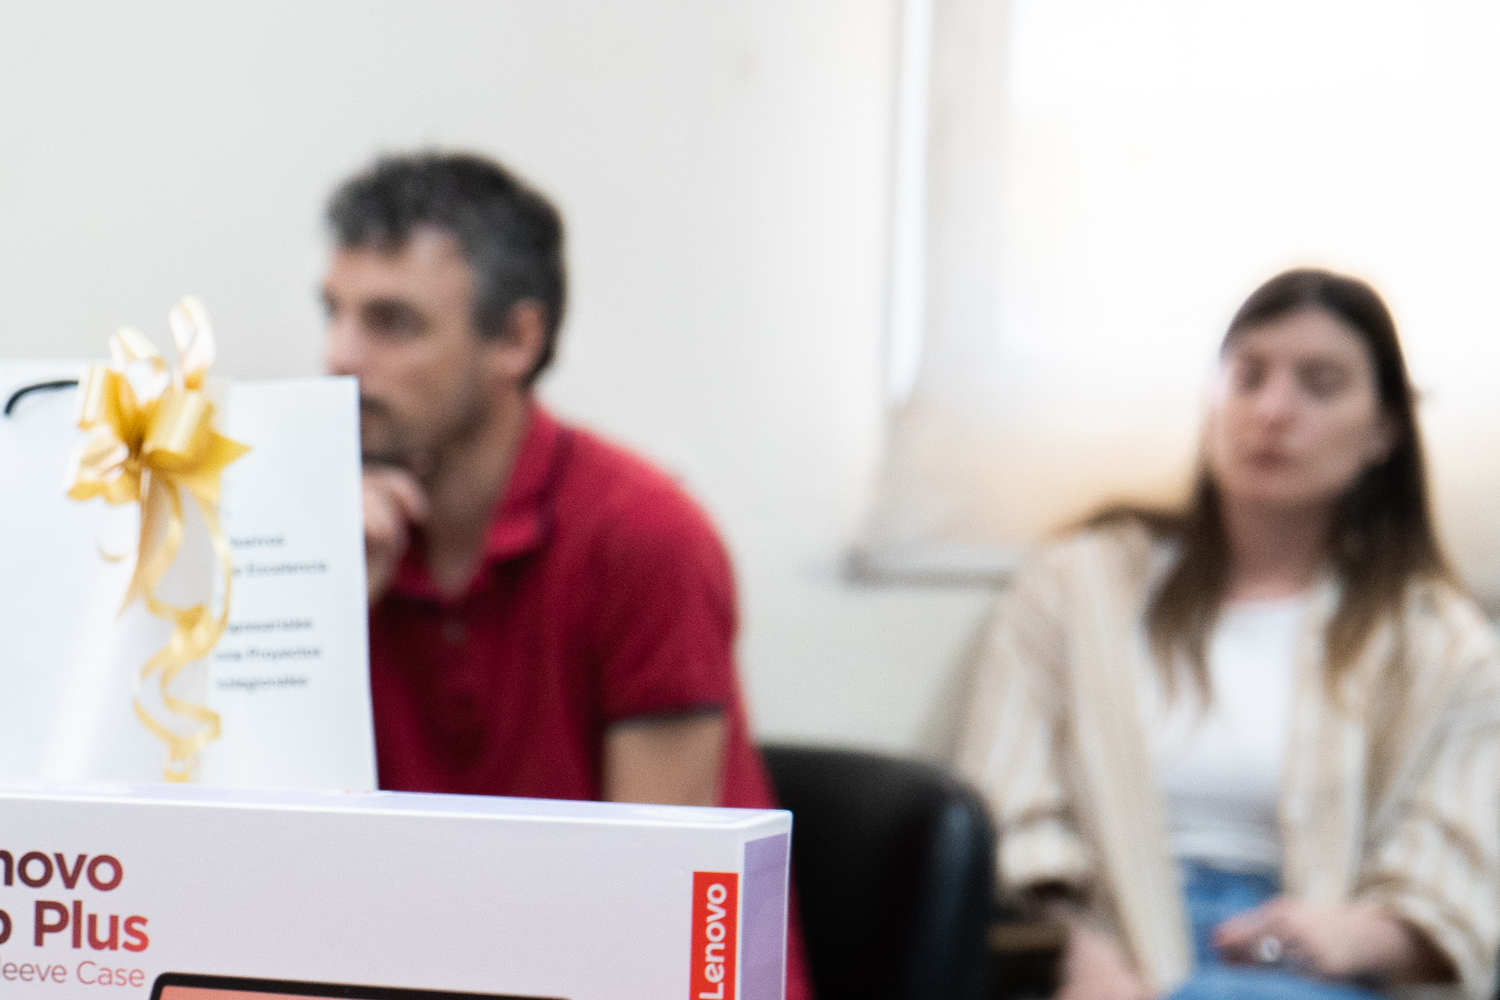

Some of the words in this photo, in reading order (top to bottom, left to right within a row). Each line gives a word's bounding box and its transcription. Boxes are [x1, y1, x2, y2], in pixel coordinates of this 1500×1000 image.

[34, 900, 149, 952] Plus
[699, 883, 727, 1000] Lenovo
[77, 961, 146, 987] Case
